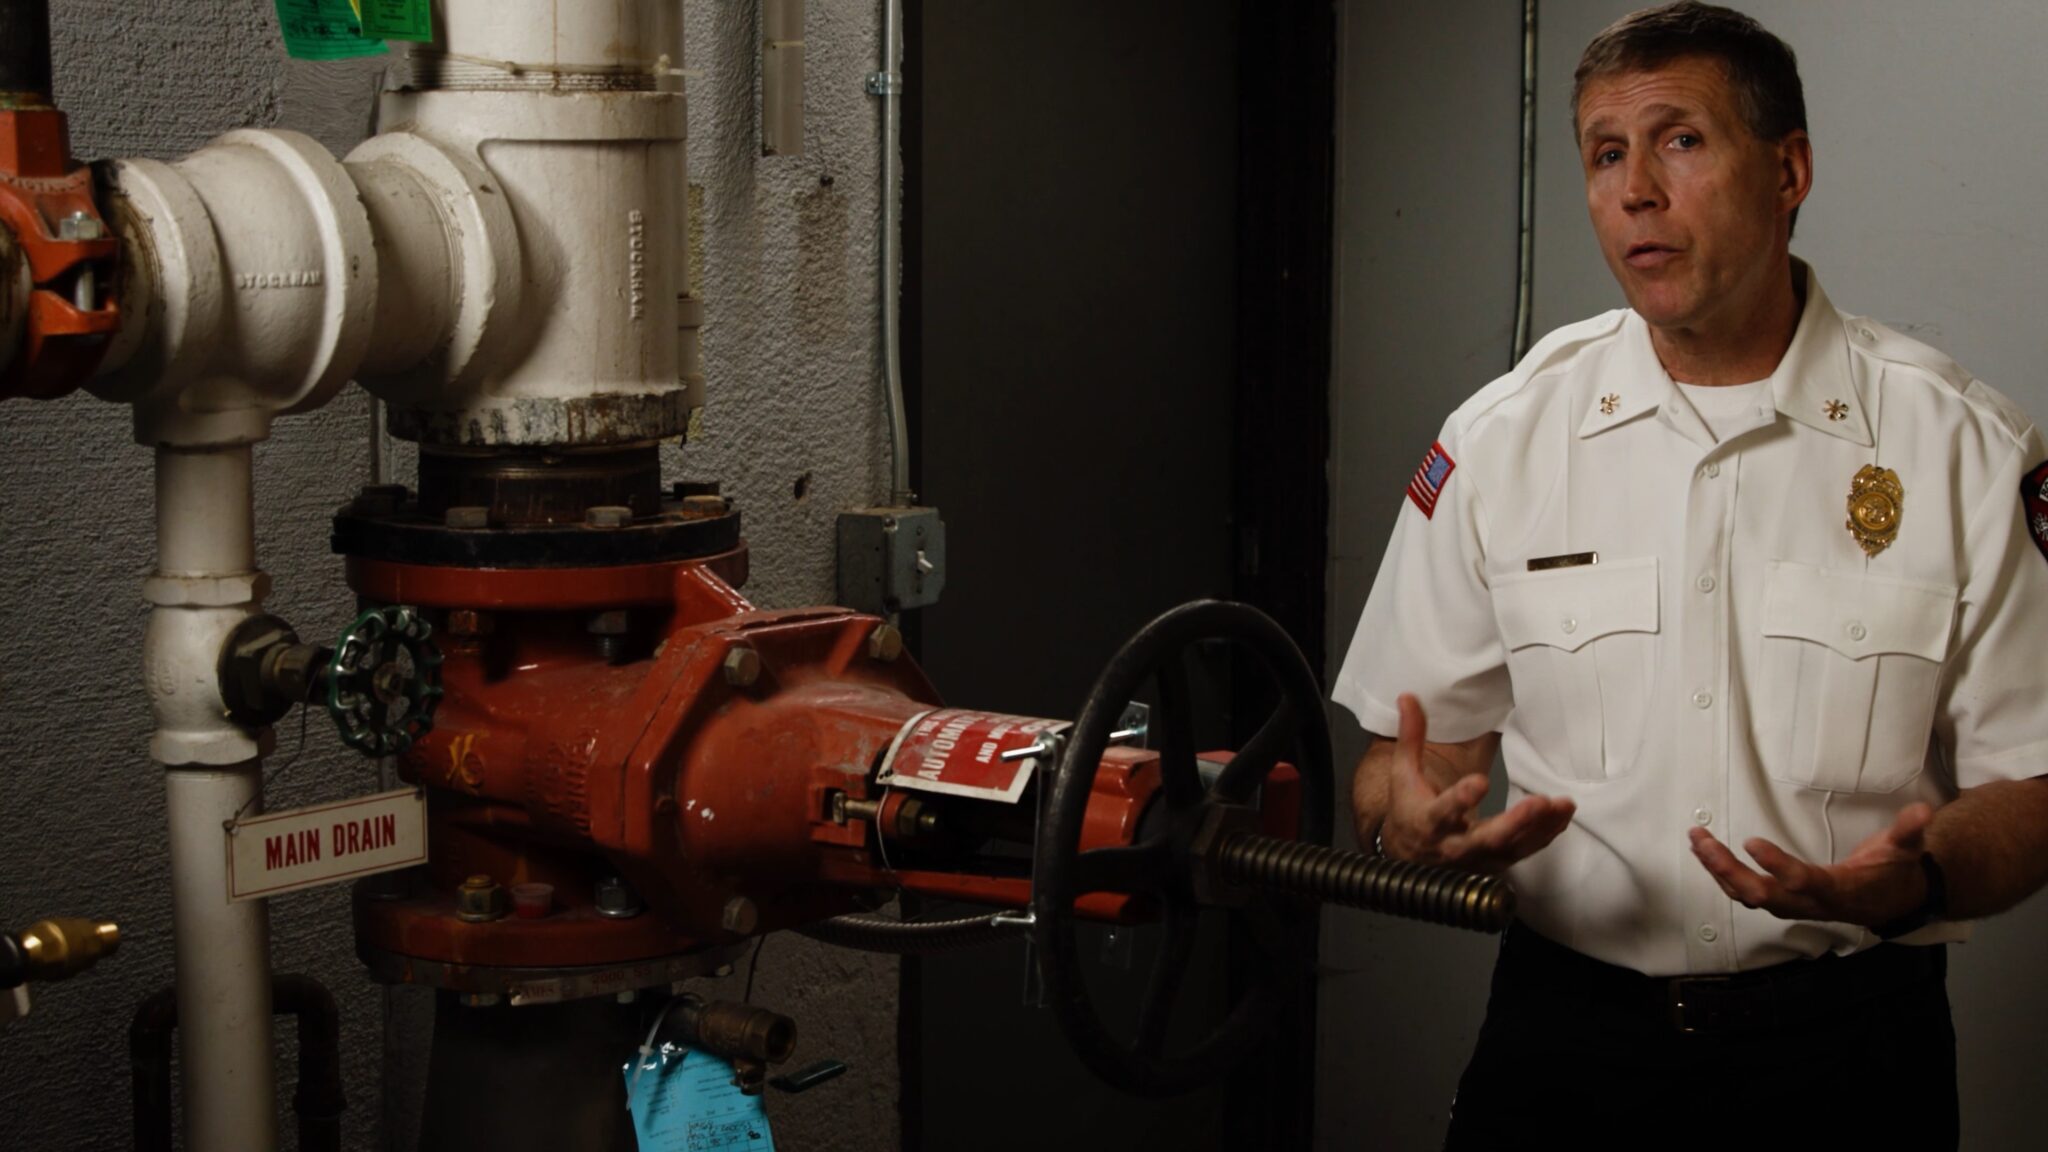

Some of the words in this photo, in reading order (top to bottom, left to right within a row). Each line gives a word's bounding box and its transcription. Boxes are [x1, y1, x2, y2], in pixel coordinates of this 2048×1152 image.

[976, 741, 998, 764] AND
[265, 828, 320, 870] MAIN
[333, 814, 396, 858] DRAIN
